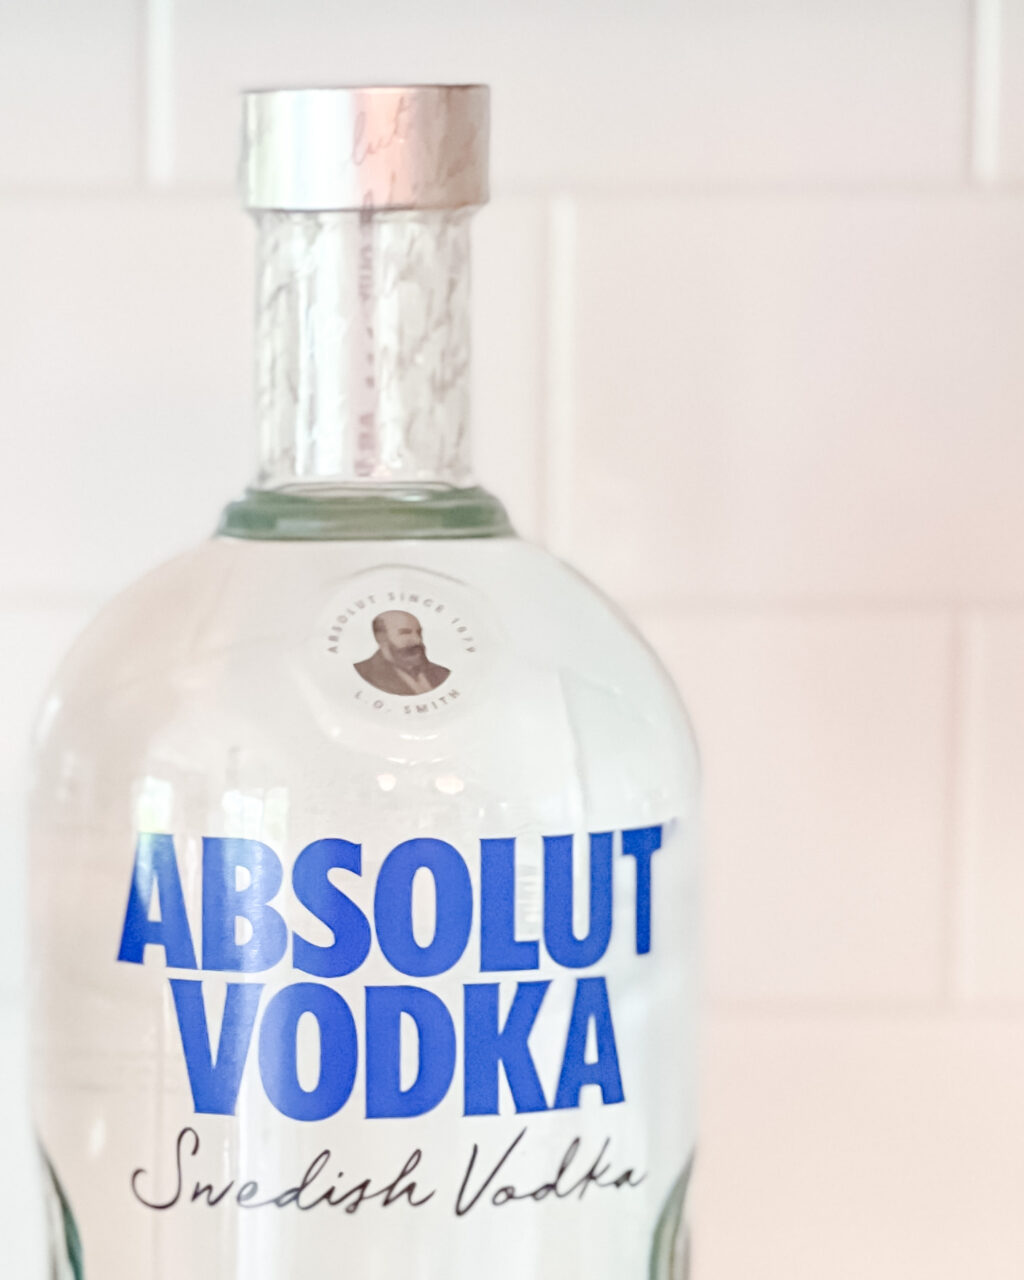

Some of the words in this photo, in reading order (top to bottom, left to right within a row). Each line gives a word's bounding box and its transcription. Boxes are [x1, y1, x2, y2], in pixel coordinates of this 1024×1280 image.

[387, 592, 445, 613] SINCE
[403, 688, 461, 714] SMITH
[116, 824, 664, 979] ABSOLUT
[168, 976, 626, 1122] VODKA
[131, 1126, 437, 1210] Swedish
[452, 1125, 648, 1217] Vodka
